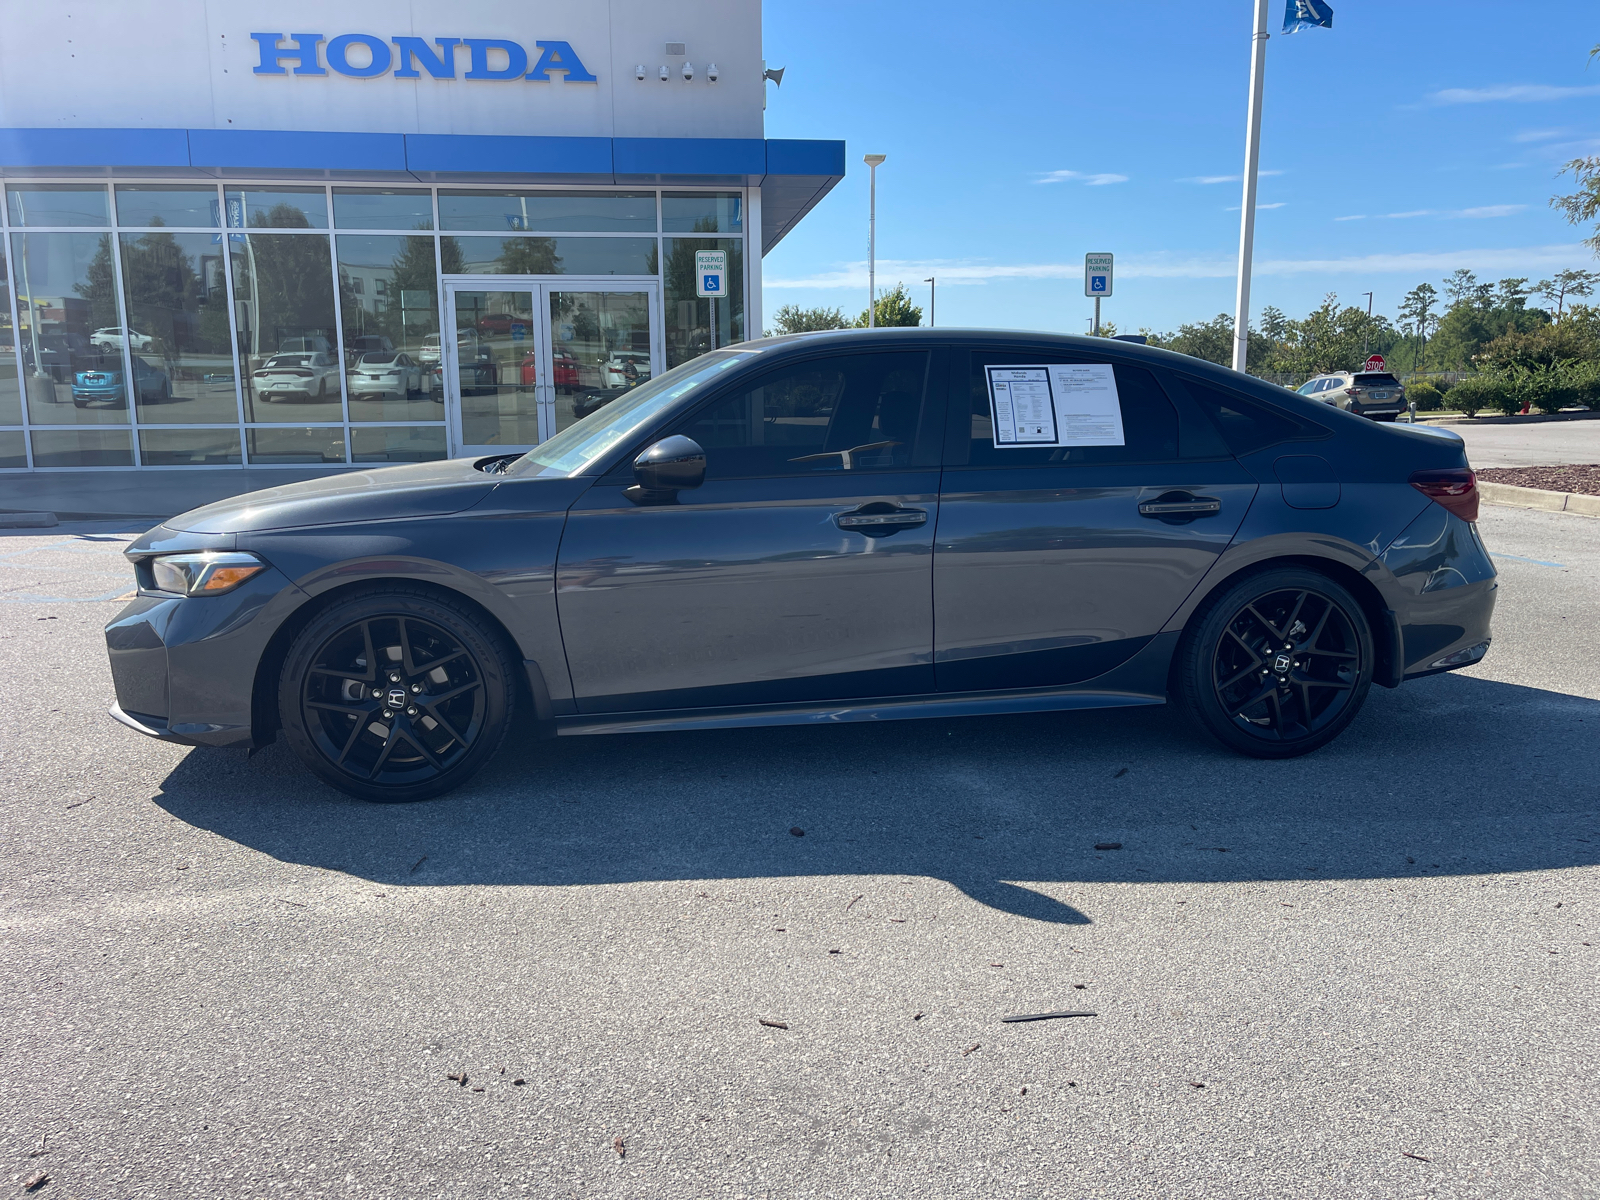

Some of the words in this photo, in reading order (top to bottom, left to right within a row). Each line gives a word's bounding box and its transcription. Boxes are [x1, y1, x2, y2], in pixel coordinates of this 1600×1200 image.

[250, 32, 597, 83] HONDA
[1366, 360, 1384, 370] STOP
[418, 606, 462, 629] EAGLE
[462, 629, 491, 664] SPORT
